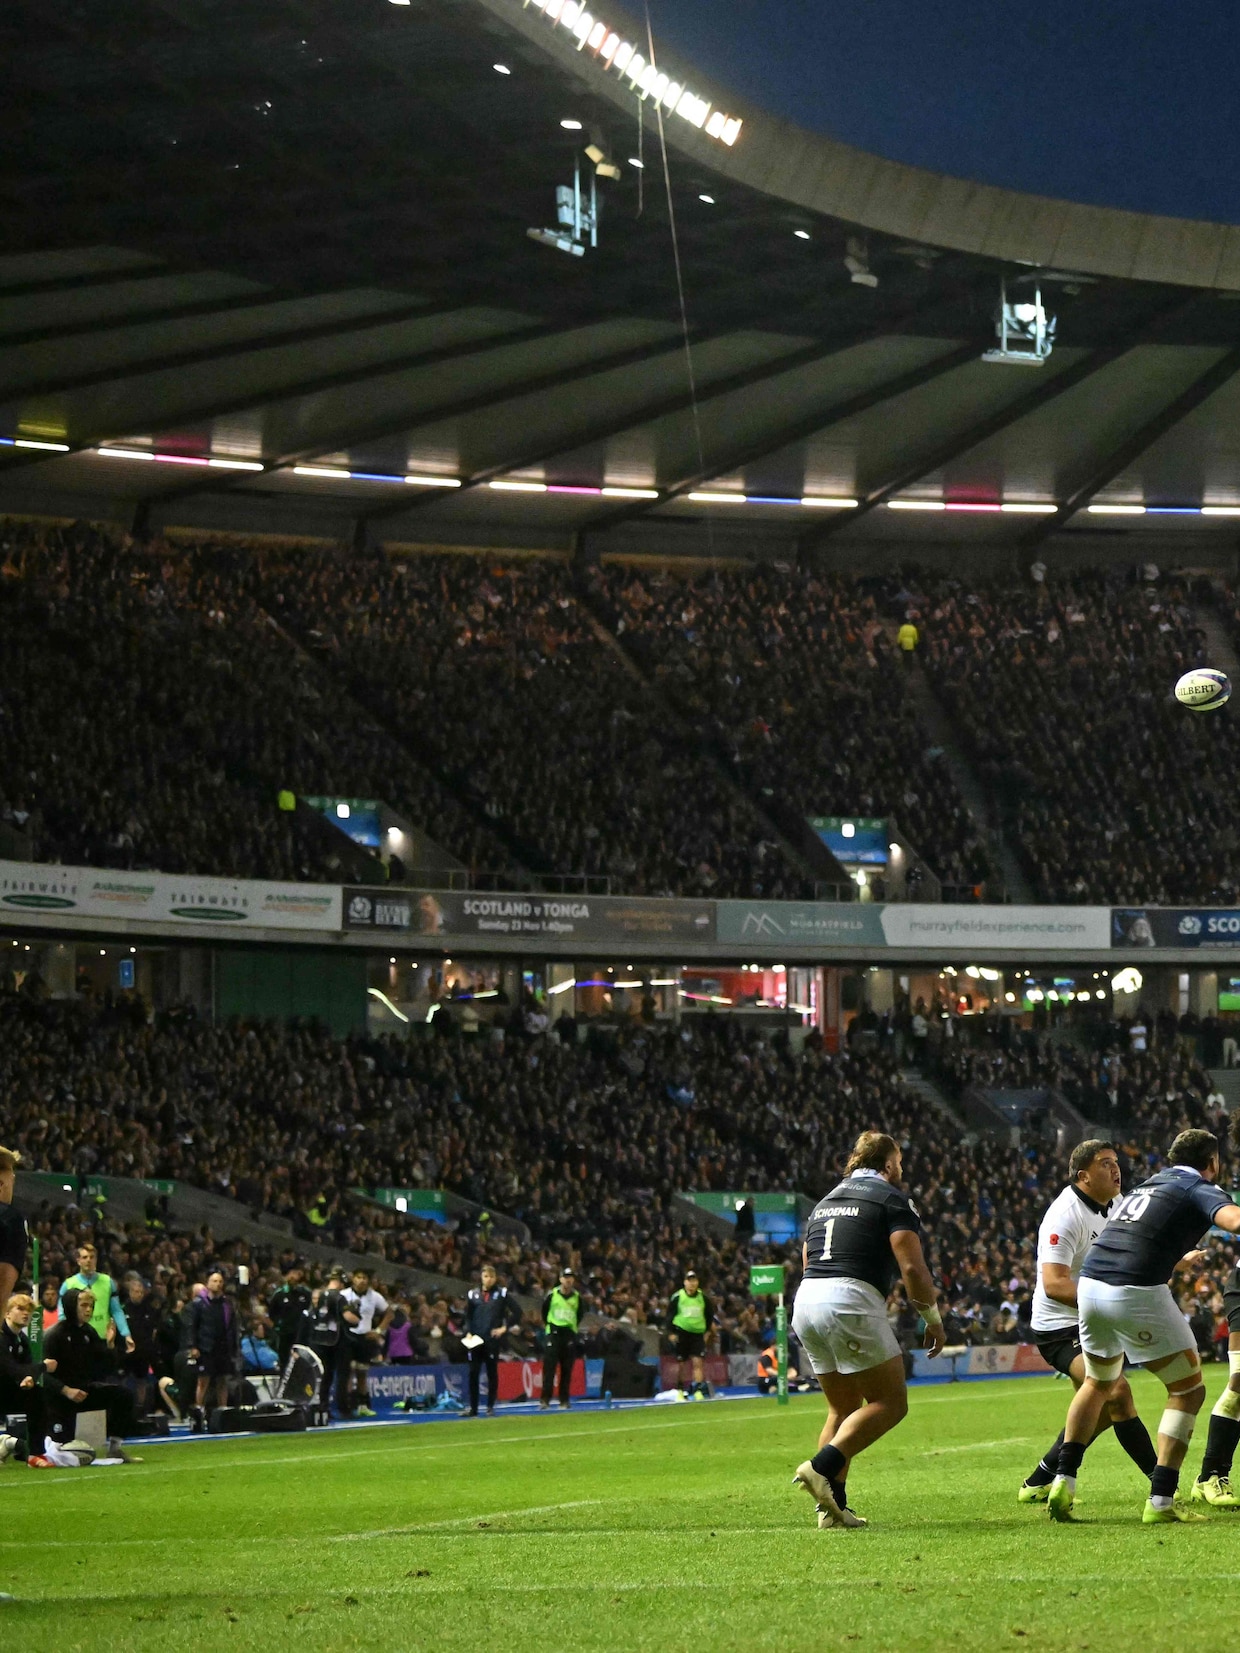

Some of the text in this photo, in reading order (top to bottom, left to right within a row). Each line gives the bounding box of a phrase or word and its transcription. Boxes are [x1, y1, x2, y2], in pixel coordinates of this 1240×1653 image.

[1177, 684, 1216, 697] GILBERT
[463, 899, 532, 917] SCOTLAND
[543, 902, 589, 919] TONGA
[813, 1206, 860, 1220] SCHOEMAN
[1110, 1194, 1151, 1223] 19
[819, 1218, 836, 1261] 1
